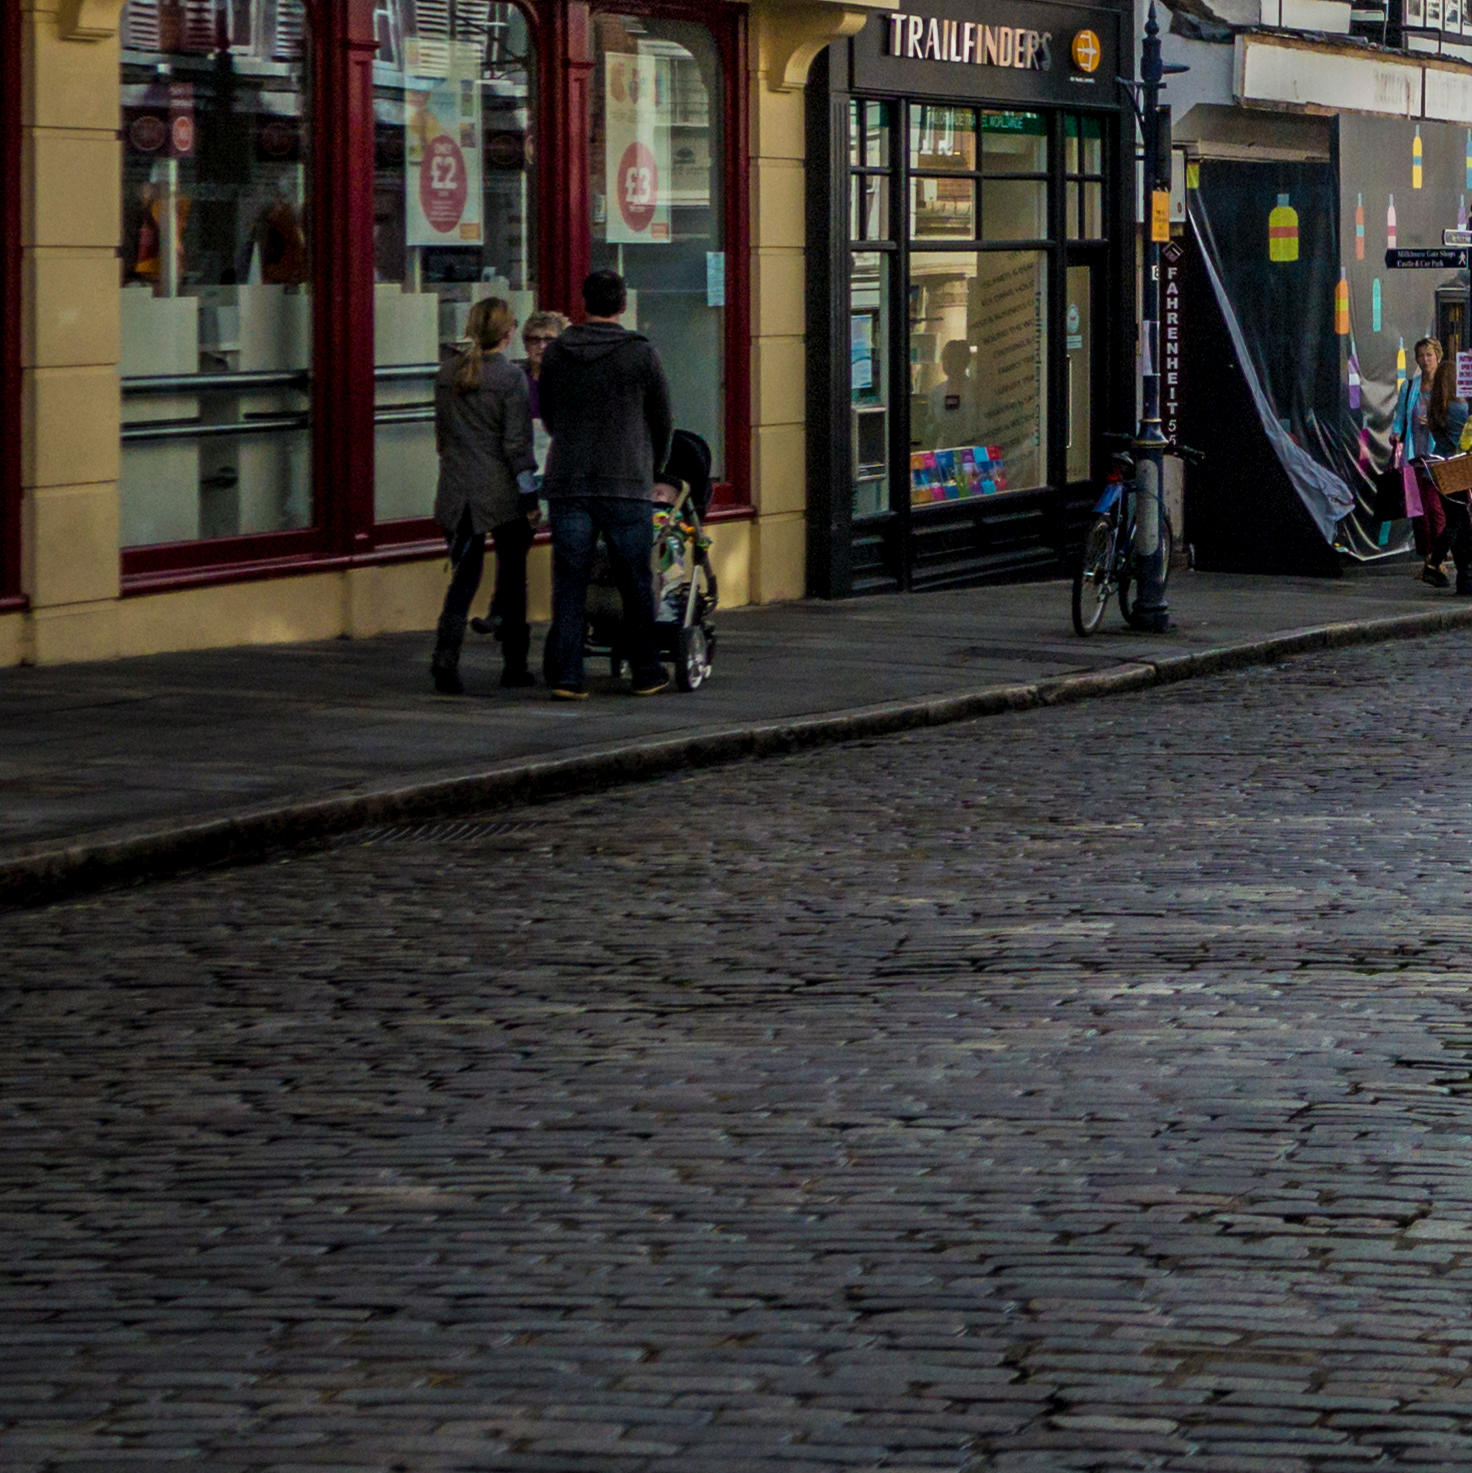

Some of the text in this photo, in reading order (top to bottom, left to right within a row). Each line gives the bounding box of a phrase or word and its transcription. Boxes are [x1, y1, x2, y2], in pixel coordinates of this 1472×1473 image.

[889, 13, 1053, 71] TRAILFINDERS
[430, 156, 458, 189] £2
[624, 166, 651, 203] £3
[1166, 266, 1179, 414] FAHRENHEIT
